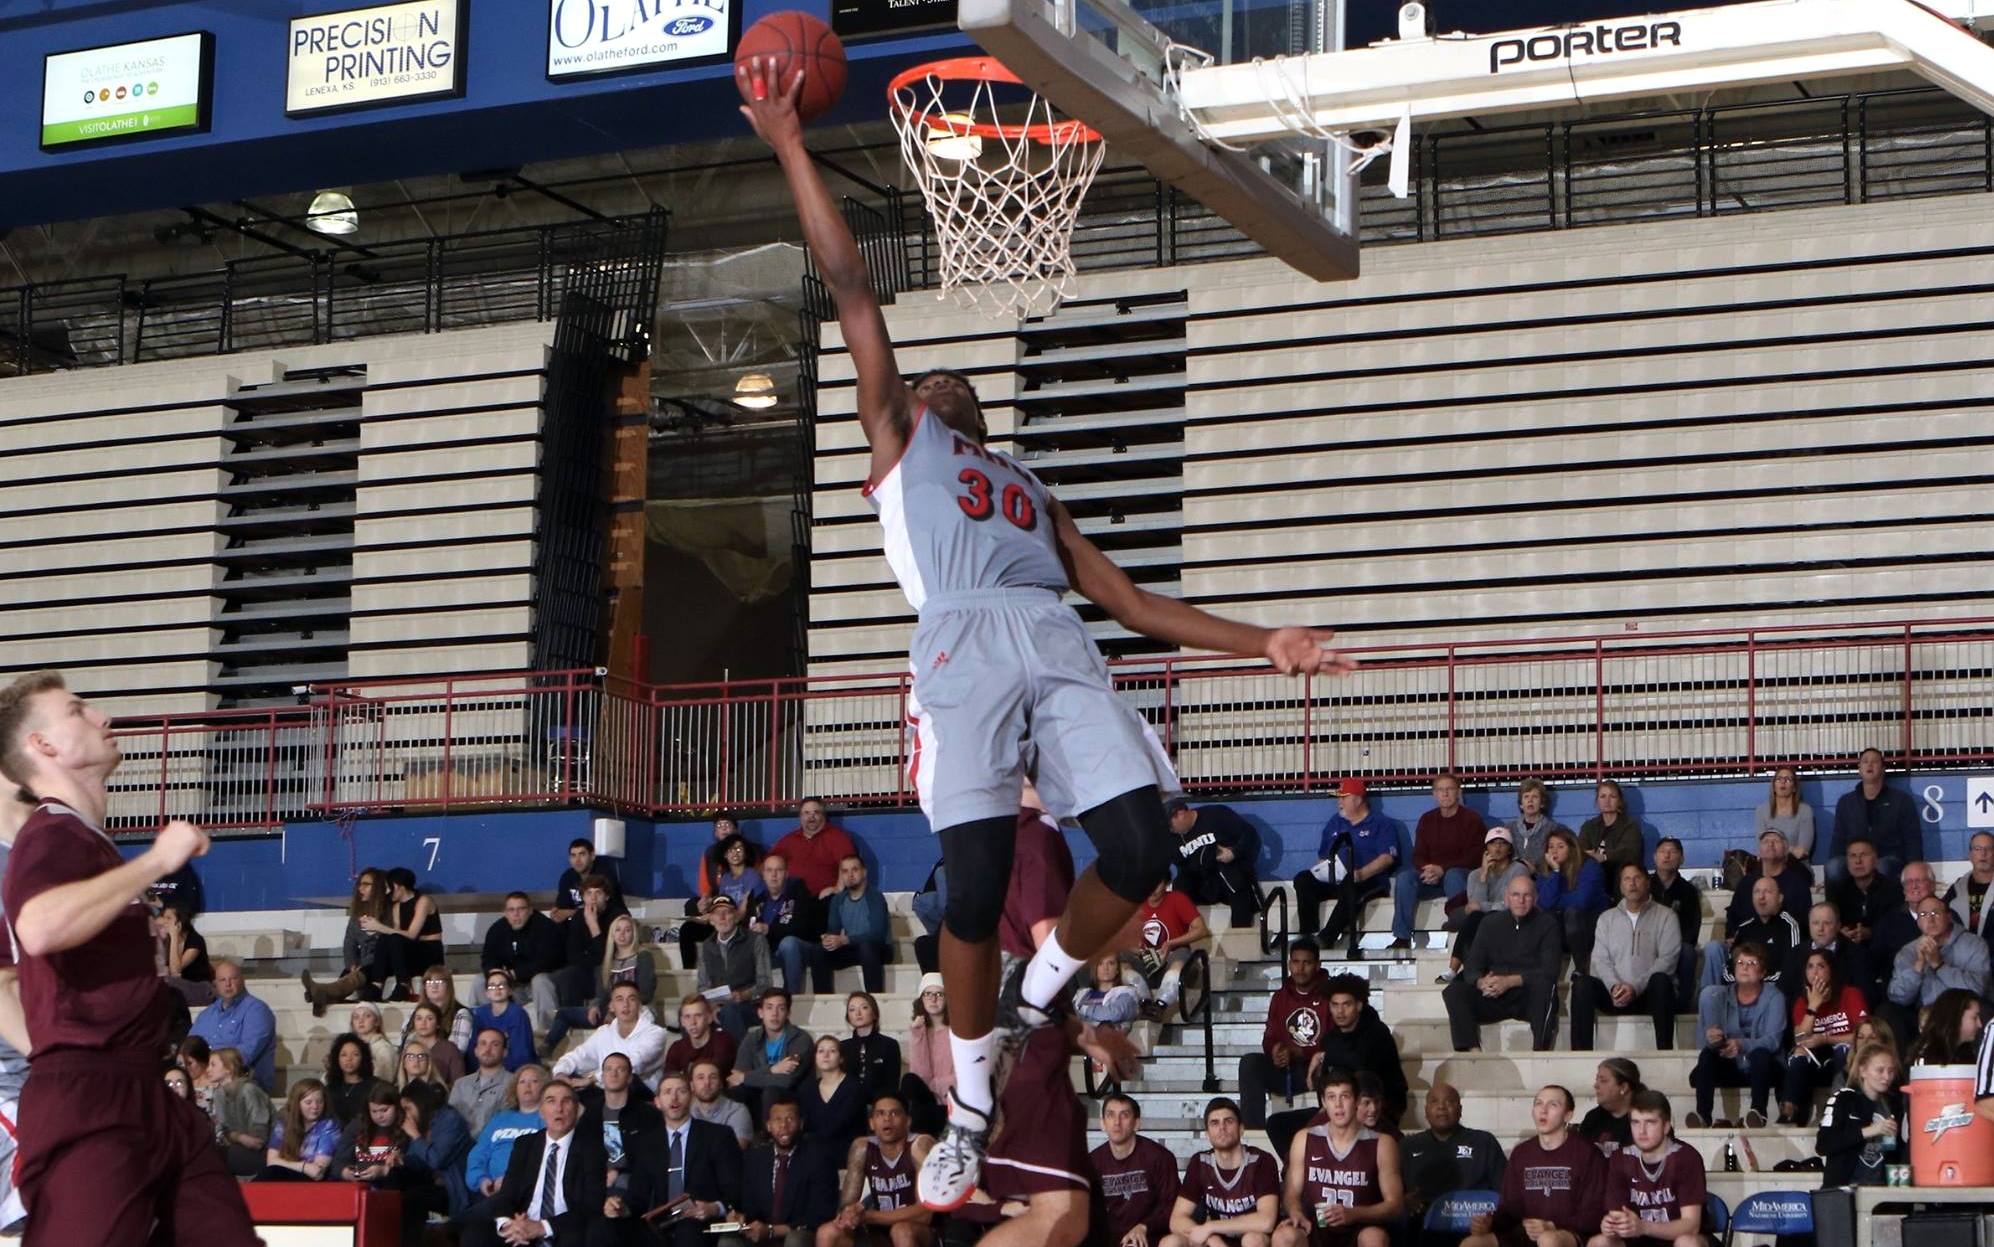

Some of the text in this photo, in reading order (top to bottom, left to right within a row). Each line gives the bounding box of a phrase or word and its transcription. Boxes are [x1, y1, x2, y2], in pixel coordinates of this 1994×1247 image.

[294, 10, 439, 57] PRECISION
[555, 0, 724, 48] OLA
[672, 17, 704, 35] Ford
[326, 40, 452, 83] PRINTING
[553, 42, 678, 66] www.olatheford.com
[370, 75, 391, 88] (913)
[957, 467, 1038, 532] 30
[1922, 784, 1944, 823] 8
[423, 837, 440, 871] 7
[1308, 1166, 1368, 1187] EVANGEL
